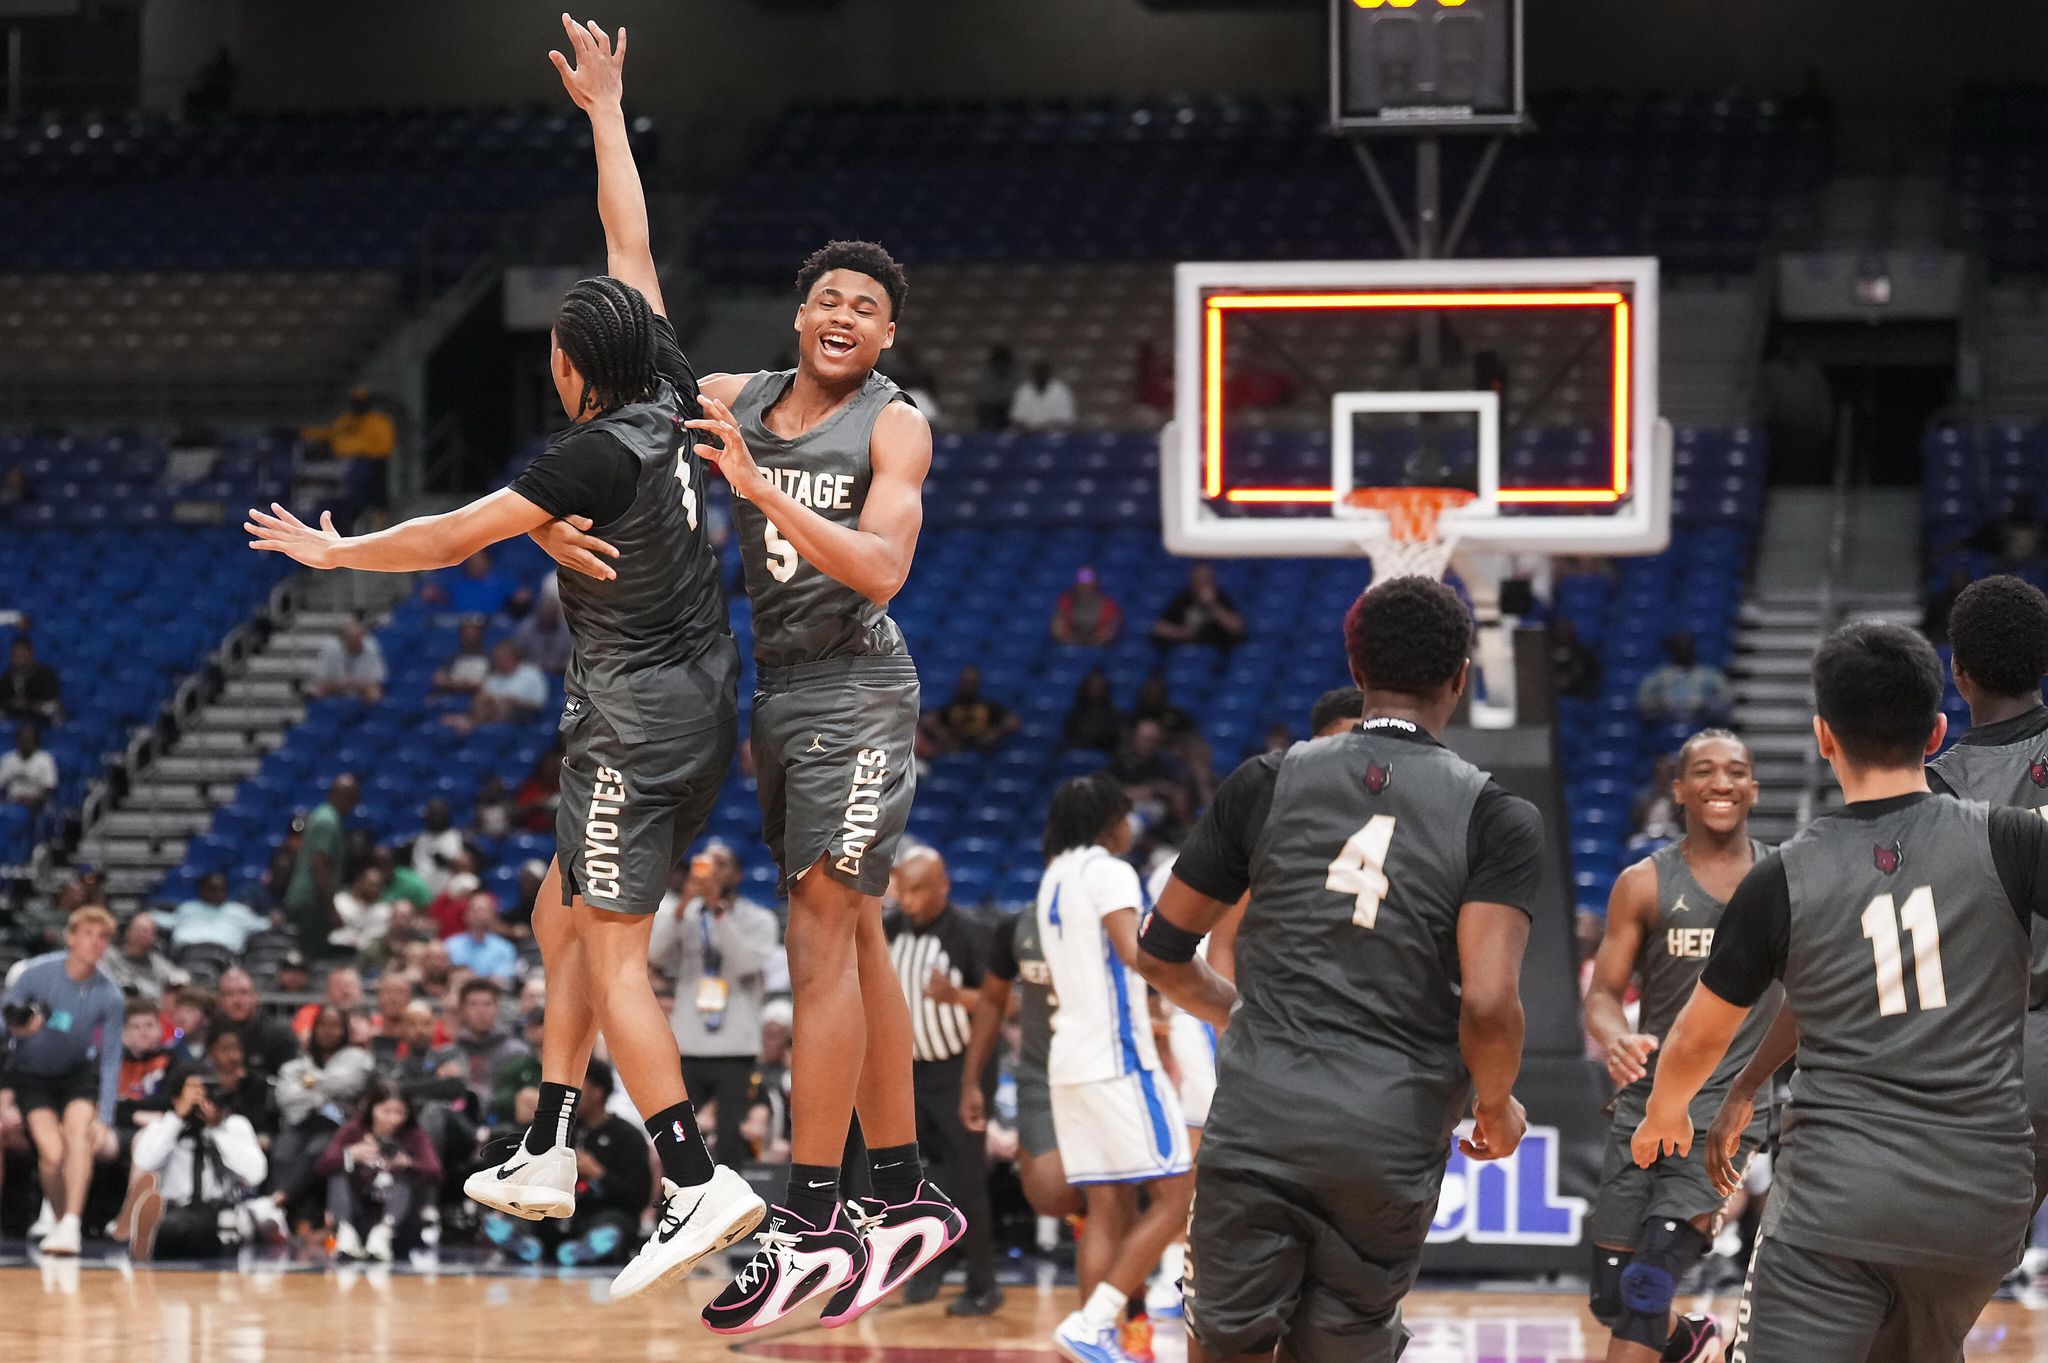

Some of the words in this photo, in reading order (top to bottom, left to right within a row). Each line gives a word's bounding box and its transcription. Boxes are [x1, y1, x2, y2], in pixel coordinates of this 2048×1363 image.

[729, 466, 854, 509] ITAGE
[764, 517, 798, 583] 5
[1363, 717, 1389, 730] NIKE
[1389, 717, 1417, 732] PRO
[585, 766, 626, 899] COYOTES
[835, 748, 888, 876] COYOTES
[1325, 814, 1396, 930] 4
[1861, 885, 1947, 1017] 11
